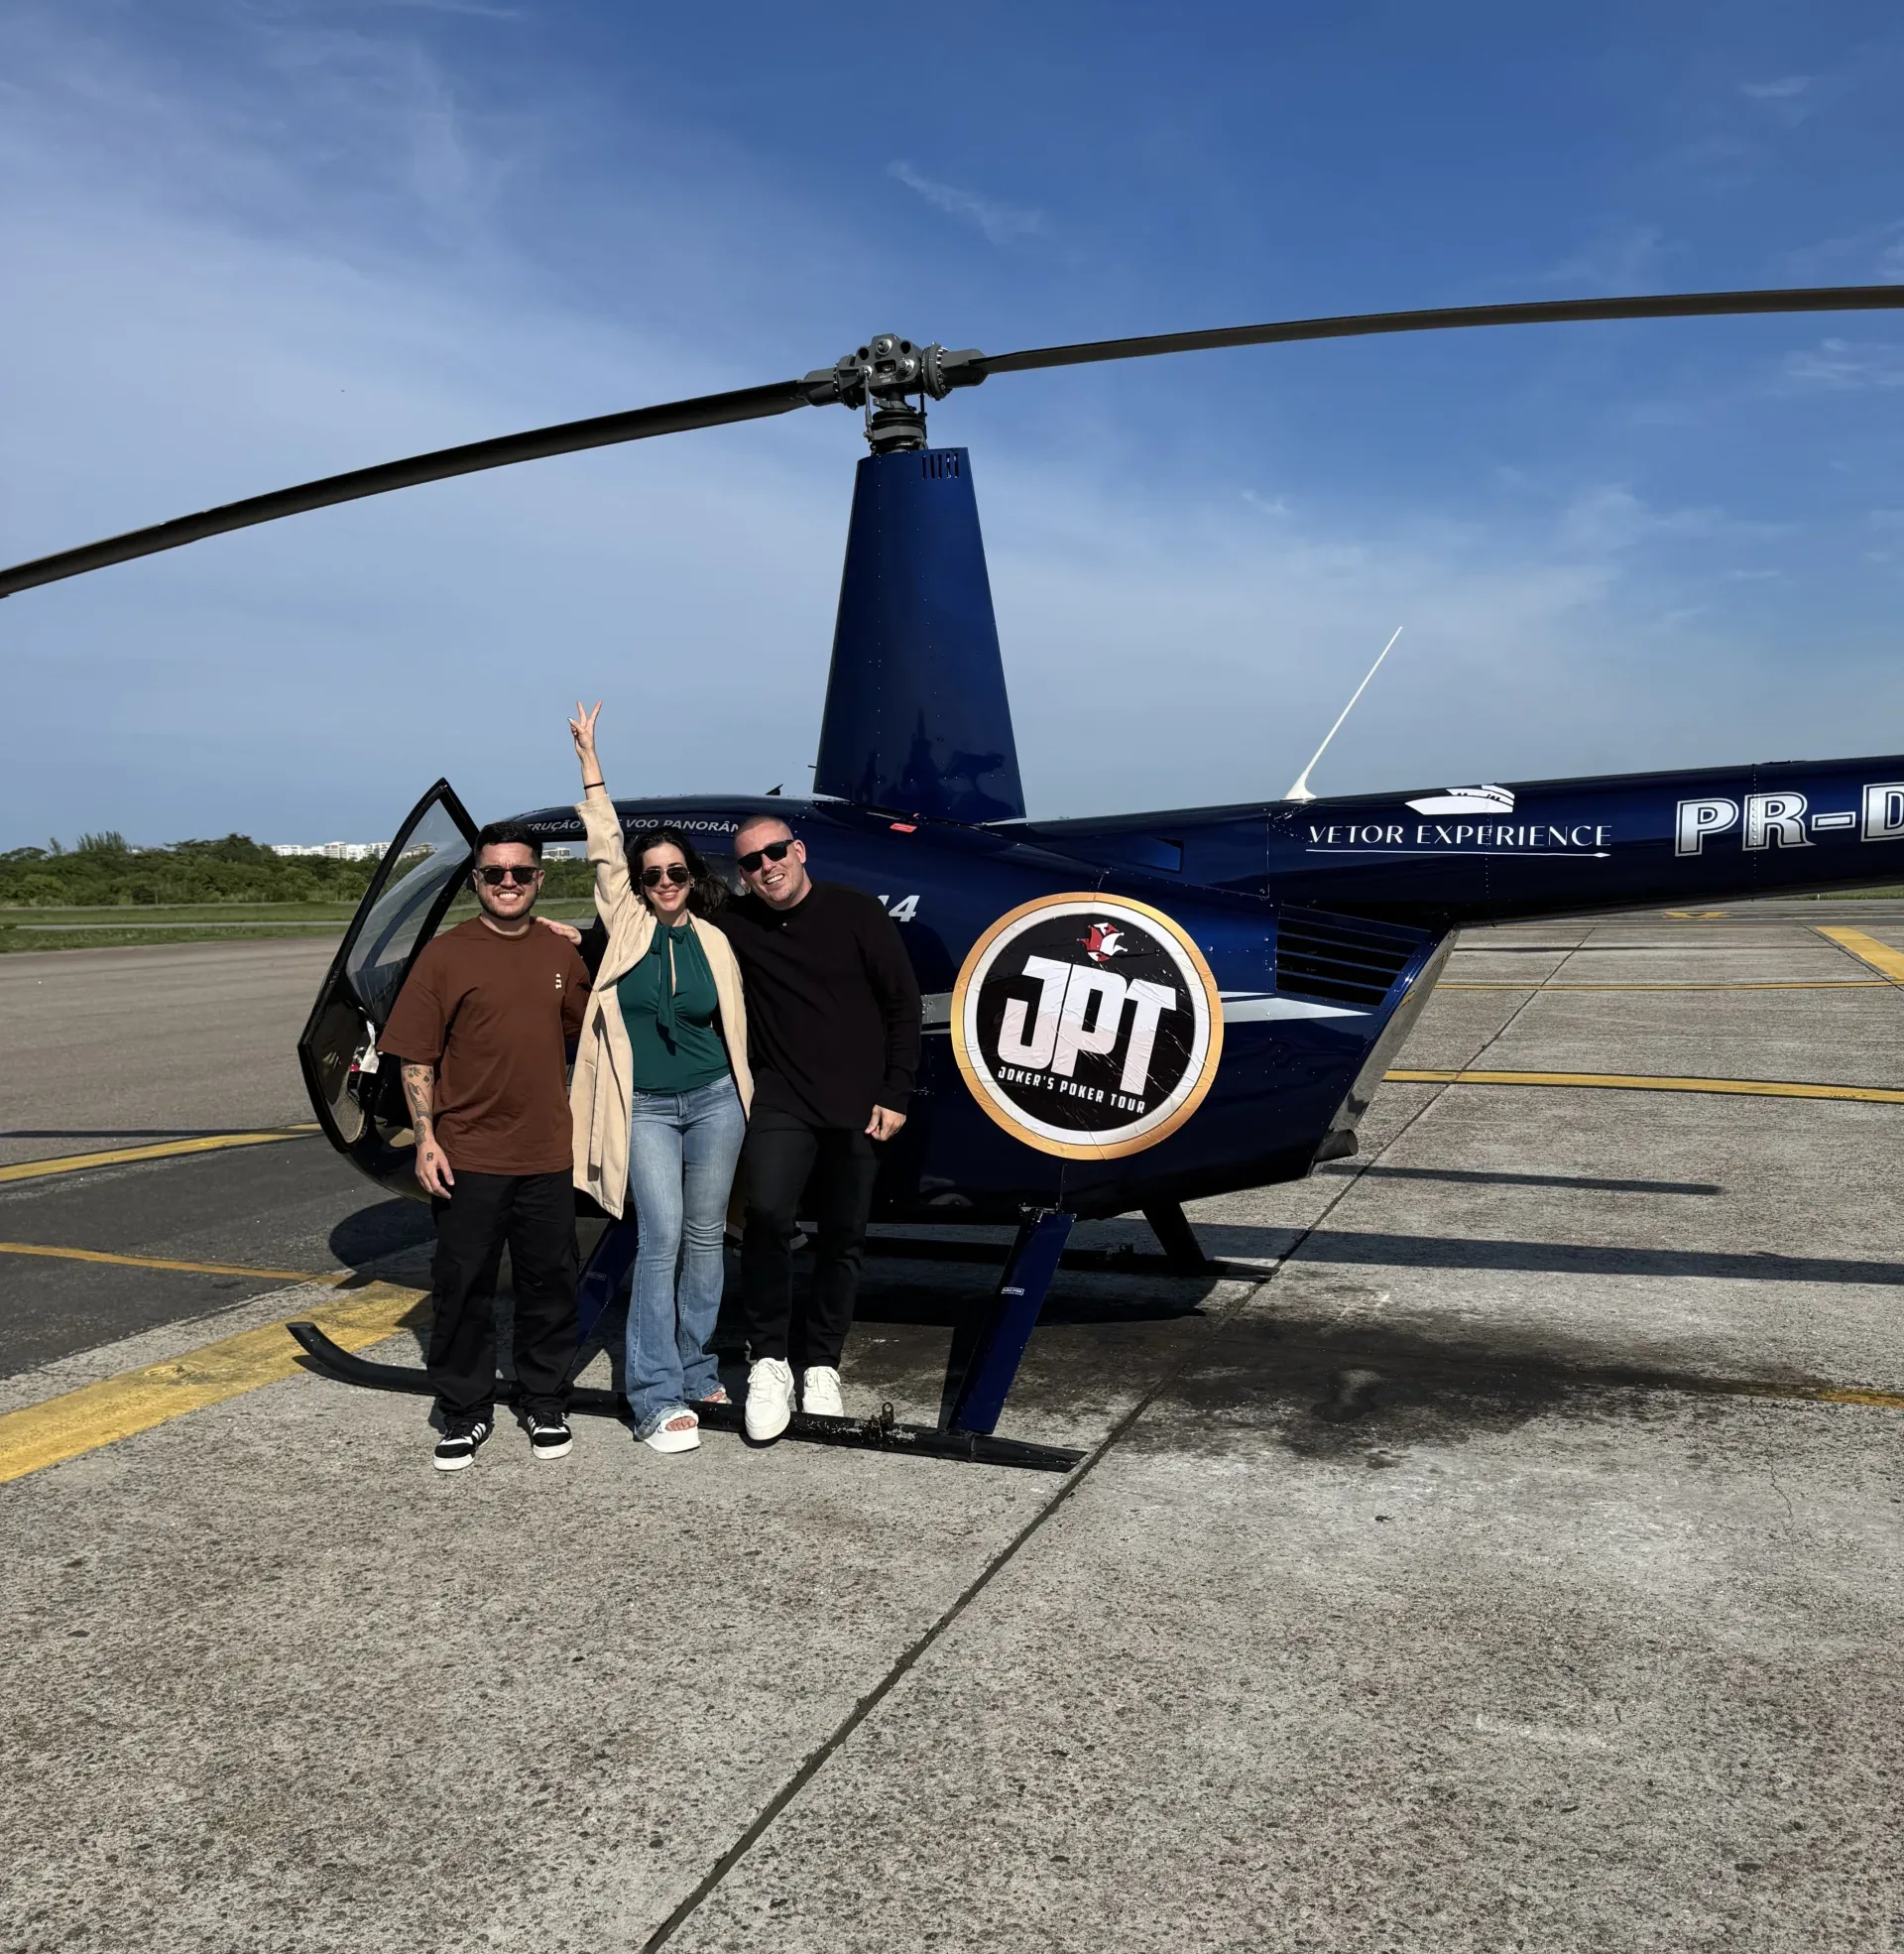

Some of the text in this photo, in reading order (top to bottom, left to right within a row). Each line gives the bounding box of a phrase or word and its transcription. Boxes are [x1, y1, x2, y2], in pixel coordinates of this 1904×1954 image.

[626, 818, 658, 828] VOO
[1309, 824, 1611, 847] VETOR EXPERIENCE
[1675, 781, 1904, 858] PR-D
[877, 895, 920, 922] 4
[997, 955, 1177, 1097] JPT
[998, 1065, 1146, 1115] JOKER'S POKER TOUR
